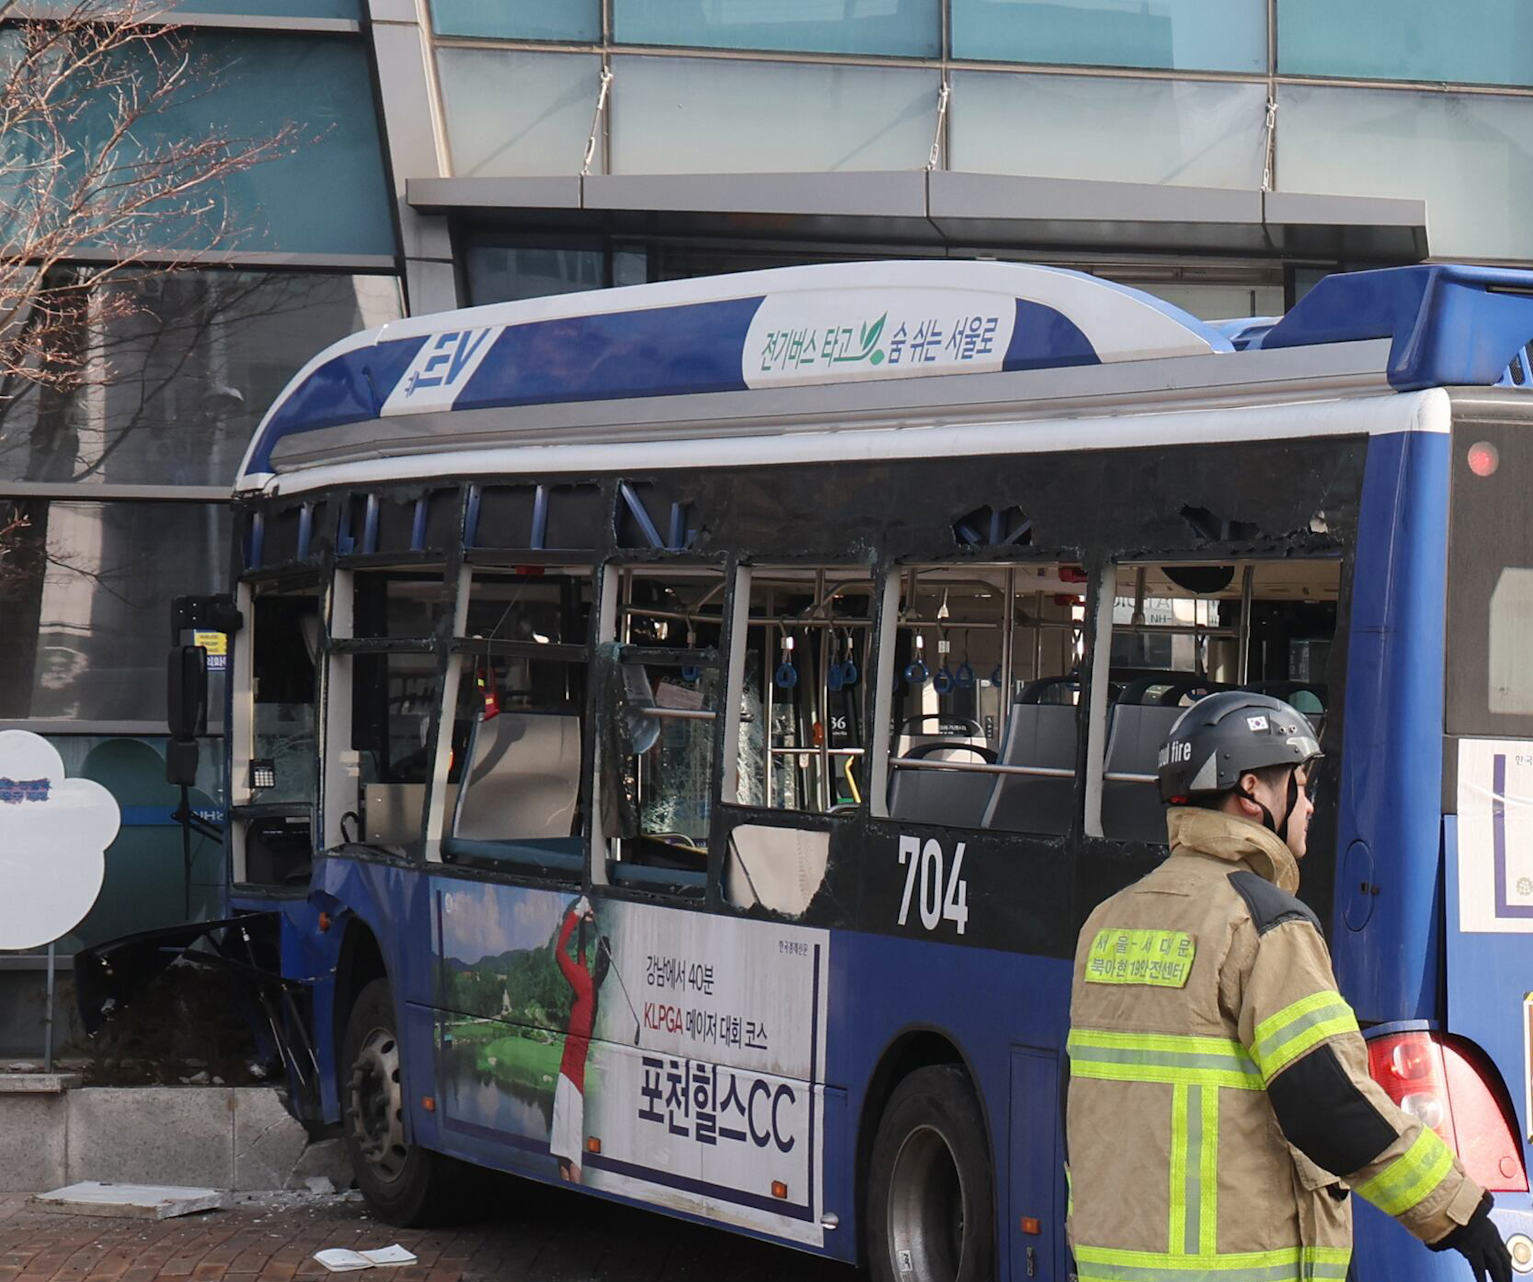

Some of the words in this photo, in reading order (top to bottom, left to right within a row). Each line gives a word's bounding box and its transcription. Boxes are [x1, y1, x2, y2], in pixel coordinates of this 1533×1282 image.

[406, 327, 493, 397] EV
[760, 327, 817, 371] 전기버스
[821, 325, 862, 368] 타고
[888, 321, 907, 364] 숨
[910, 319, 942, 362] 쉬는
[945, 316, 999, 360] 서울로
[1171, 740, 1192, 763] fire
[898, 834, 968, 935] 704
[646, 954, 686, 992] 강남에서
[688, 962, 715, 996] 40분
[643, 1001, 684, 1035] KLPGA
[686, 1008, 717, 1045] 메이저
[720, 1013, 742, 1049] 대회
[744, 1020, 768, 1050] 코스
[638, 1055, 796, 1154] 포천힐스CC
